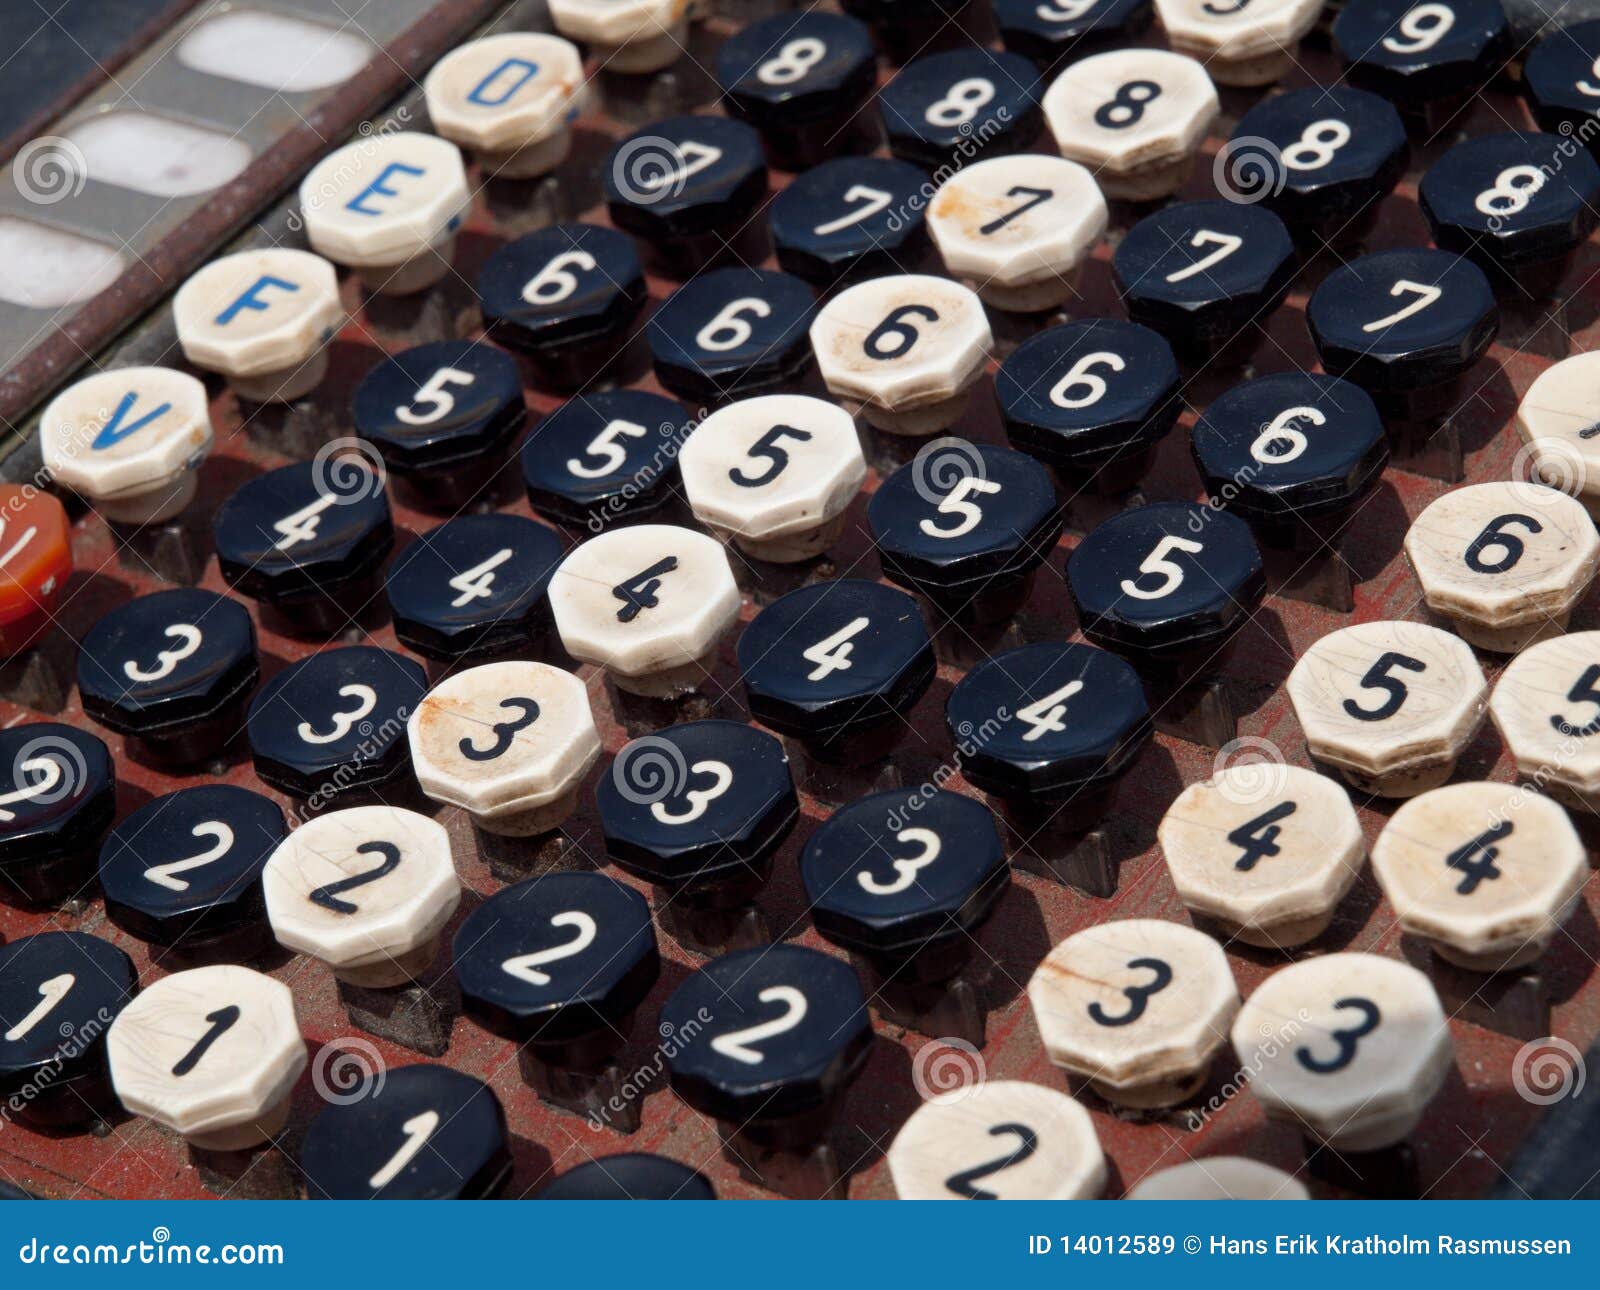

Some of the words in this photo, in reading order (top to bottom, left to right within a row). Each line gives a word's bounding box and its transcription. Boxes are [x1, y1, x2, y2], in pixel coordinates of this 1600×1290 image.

[1384, 4, 1454, 52] 9
[467, 59, 538, 105] D
[759, 39, 825, 83] 8
[926, 79, 994, 126] 8
[1095, 81, 1161, 129] 8
[645, 142, 720, 188] 7
[1280, 120, 1350, 170] 8
[346, 162, 424, 215] E
[816, 186, 891, 234] 7
[980, 187, 1053, 234] 7
[1476, 166, 1546, 216] 8
[523, 251, 595, 304] 6
[1167, 230, 1242, 282] 7
[216, 275, 297, 325] F
[697, 298, 770, 350] 6
[1363, 280, 1441, 331] 7
[864, 305, 939, 360] 6
[396, 368, 474, 424] 5
[1050, 352, 1125, 408] 6
[92, 392, 171, 450] V
[568, 420, 646, 478] 5
[1251, 407, 1325, 463] 6
[729, 425, 811, 487] 5
[275, 493, 338, 550] 4
[920, 476, 1001, 538] 5
[1121, 536, 1203, 599] 5
[1465, 514, 1542, 574] 6
[450, 549, 512, 606] 4
[613, 557, 678, 623] 4
[124, 624, 201, 681] 3
[804, 618, 869, 680] 4
[298, 685, 376, 743] 3
[1017, 681, 1083, 740] 4
[1343, 652, 1426, 721] 5
[1549, 663, 1600, 738] 5
[459, 698, 539, 761] 3
[0, 757, 60, 822] 2
[651, 761, 732, 824] 3
[144, 821, 233, 891] 2
[858, 828, 940, 894] 3
[1228, 802, 1296, 871] 4
[1447, 821, 1513, 895] 4
[309, 842, 400, 915] 2
[502, 912, 596, 985] 2
[6, 974, 75, 1040] 1
[1088, 959, 1172, 1027] 3
[172, 1006, 239, 1076] 1
[712, 986, 806, 1063] 2
[1295, 998, 1381, 1075] 3
[371, 1111, 438, 1187] 1
[946, 1124, 1037, 1200] 2
